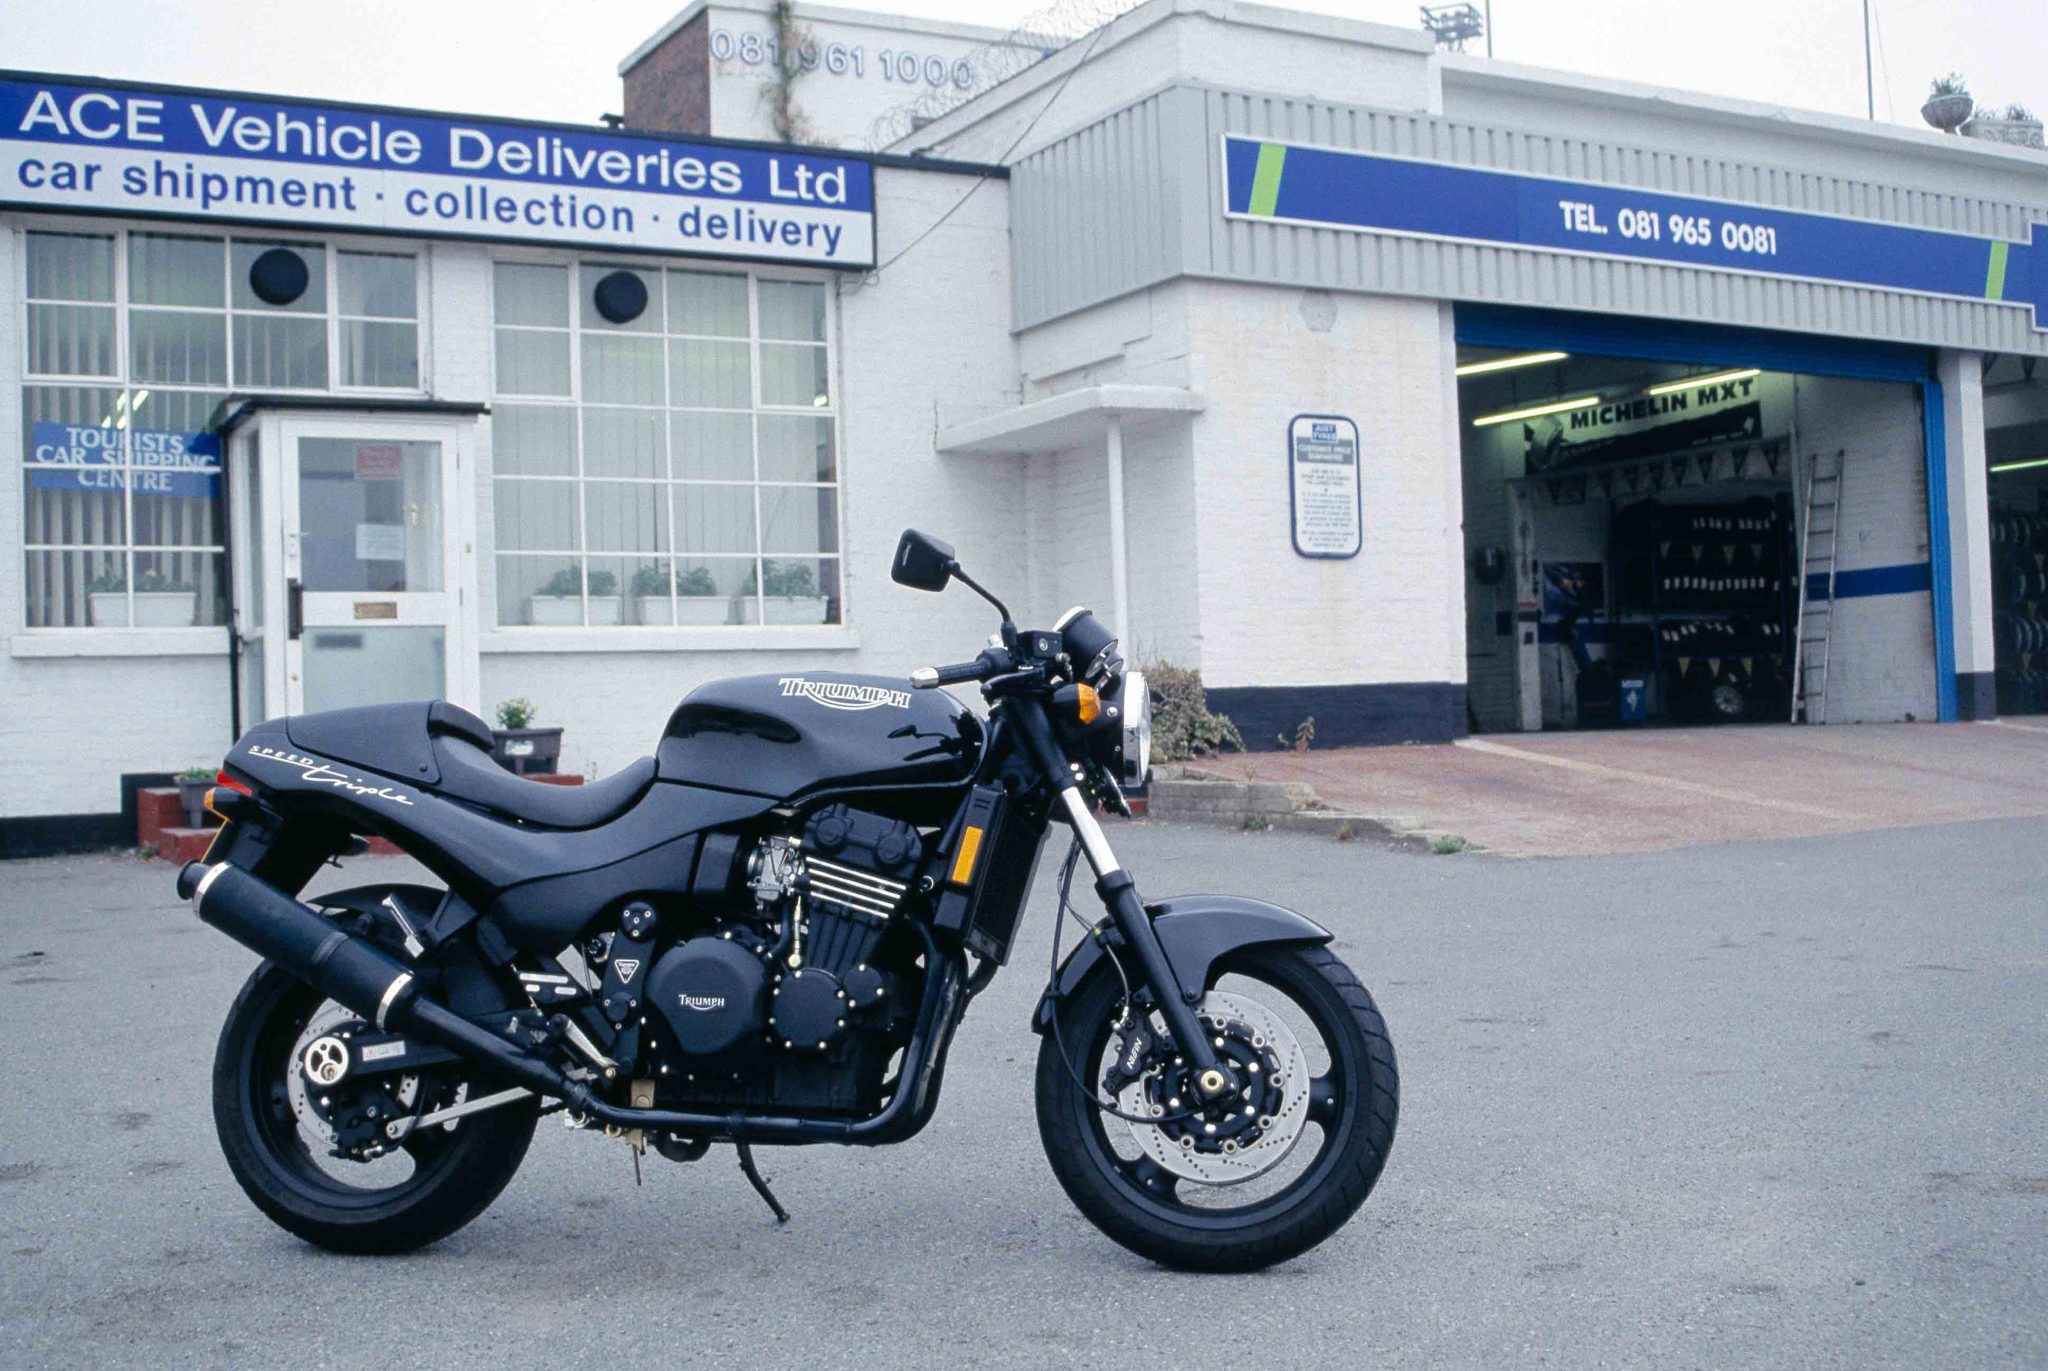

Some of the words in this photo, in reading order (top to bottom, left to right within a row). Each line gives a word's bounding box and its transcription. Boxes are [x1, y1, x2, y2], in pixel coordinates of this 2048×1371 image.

[799, 42, 864, 77] 961
[880, 49, 975, 88] 1000
[19, 91, 164, 142] ACE
[191, 103, 422, 164] Vehicle
[450, 128, 743, 194] Deliveries
[770, 159, 847, 203] Ltd
[18, 158, 102, 191] car
[123, 160, 356, 210] shipment
[405, 184, 634, 232] collection
[679, 206, 842, 255] delivery
[1559, 201, 1608, 234] TEL.
[1618, 208, 1660, 240] 081
[1669, 216, 1711, 246] 965
[1721, 222, 1776, 255] 0081
[1571, 393, 1687, 429] MICHELIN
[1698, 378, 1753, 406] MXT
[36, 445, 86, 464] CAR
[778, 678, 912, 709] TRIUMPH
[249, 745, 313, 765] SPEED
[678, 994, 725, 1009] TRIUMPH
